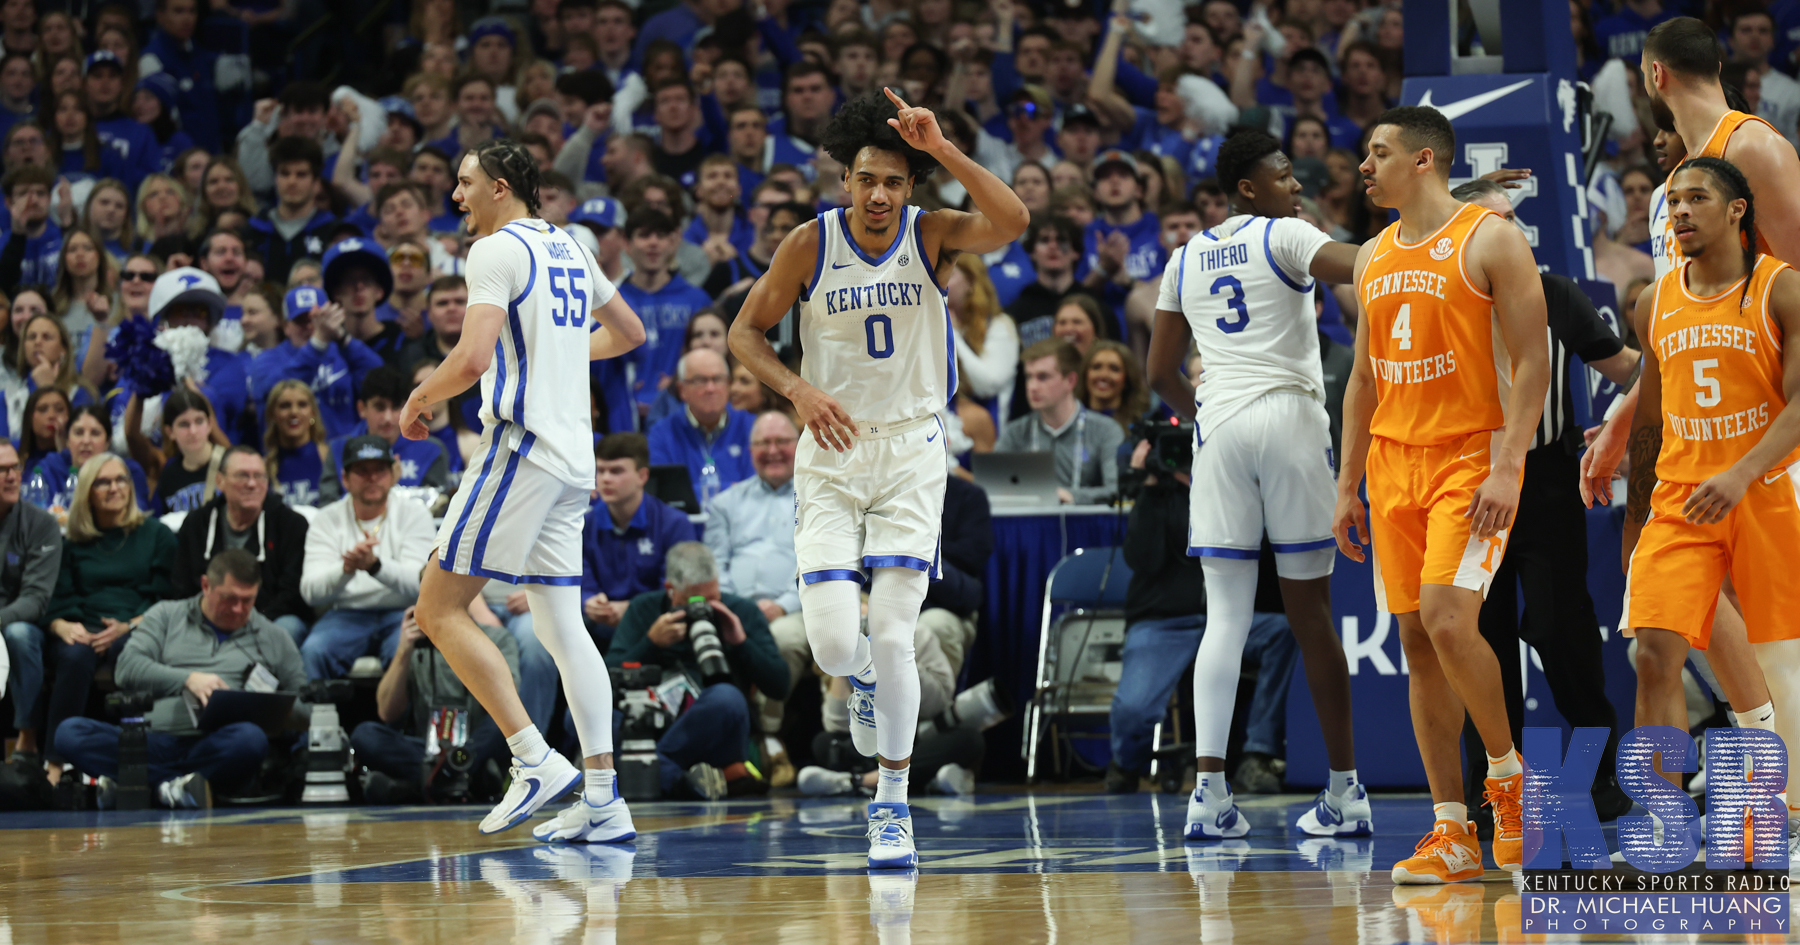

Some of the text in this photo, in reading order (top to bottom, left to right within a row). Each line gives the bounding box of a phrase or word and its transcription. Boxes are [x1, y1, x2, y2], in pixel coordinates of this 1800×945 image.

[542, 241, 574, 260] WARE
[1199, 243, 1248, 272] THIERO
[1436, 237, 1453, 254] SEC
[547, 266, 587, 328] 55
[826, 282, 923, 316] KENTUCKY
[1210, 274, 1251, 335] 3
[1365, 269, 1447, 305] TENNESSEE
[864, 313, 895, 360] 0
[1391, 303, 1412, 350] 4
[1659, 323, 1756, 362] TENNESSEE
[1692, 358, 1722, 408] 5
[1667, 401, 1768, 441] VOLUNTEERS
